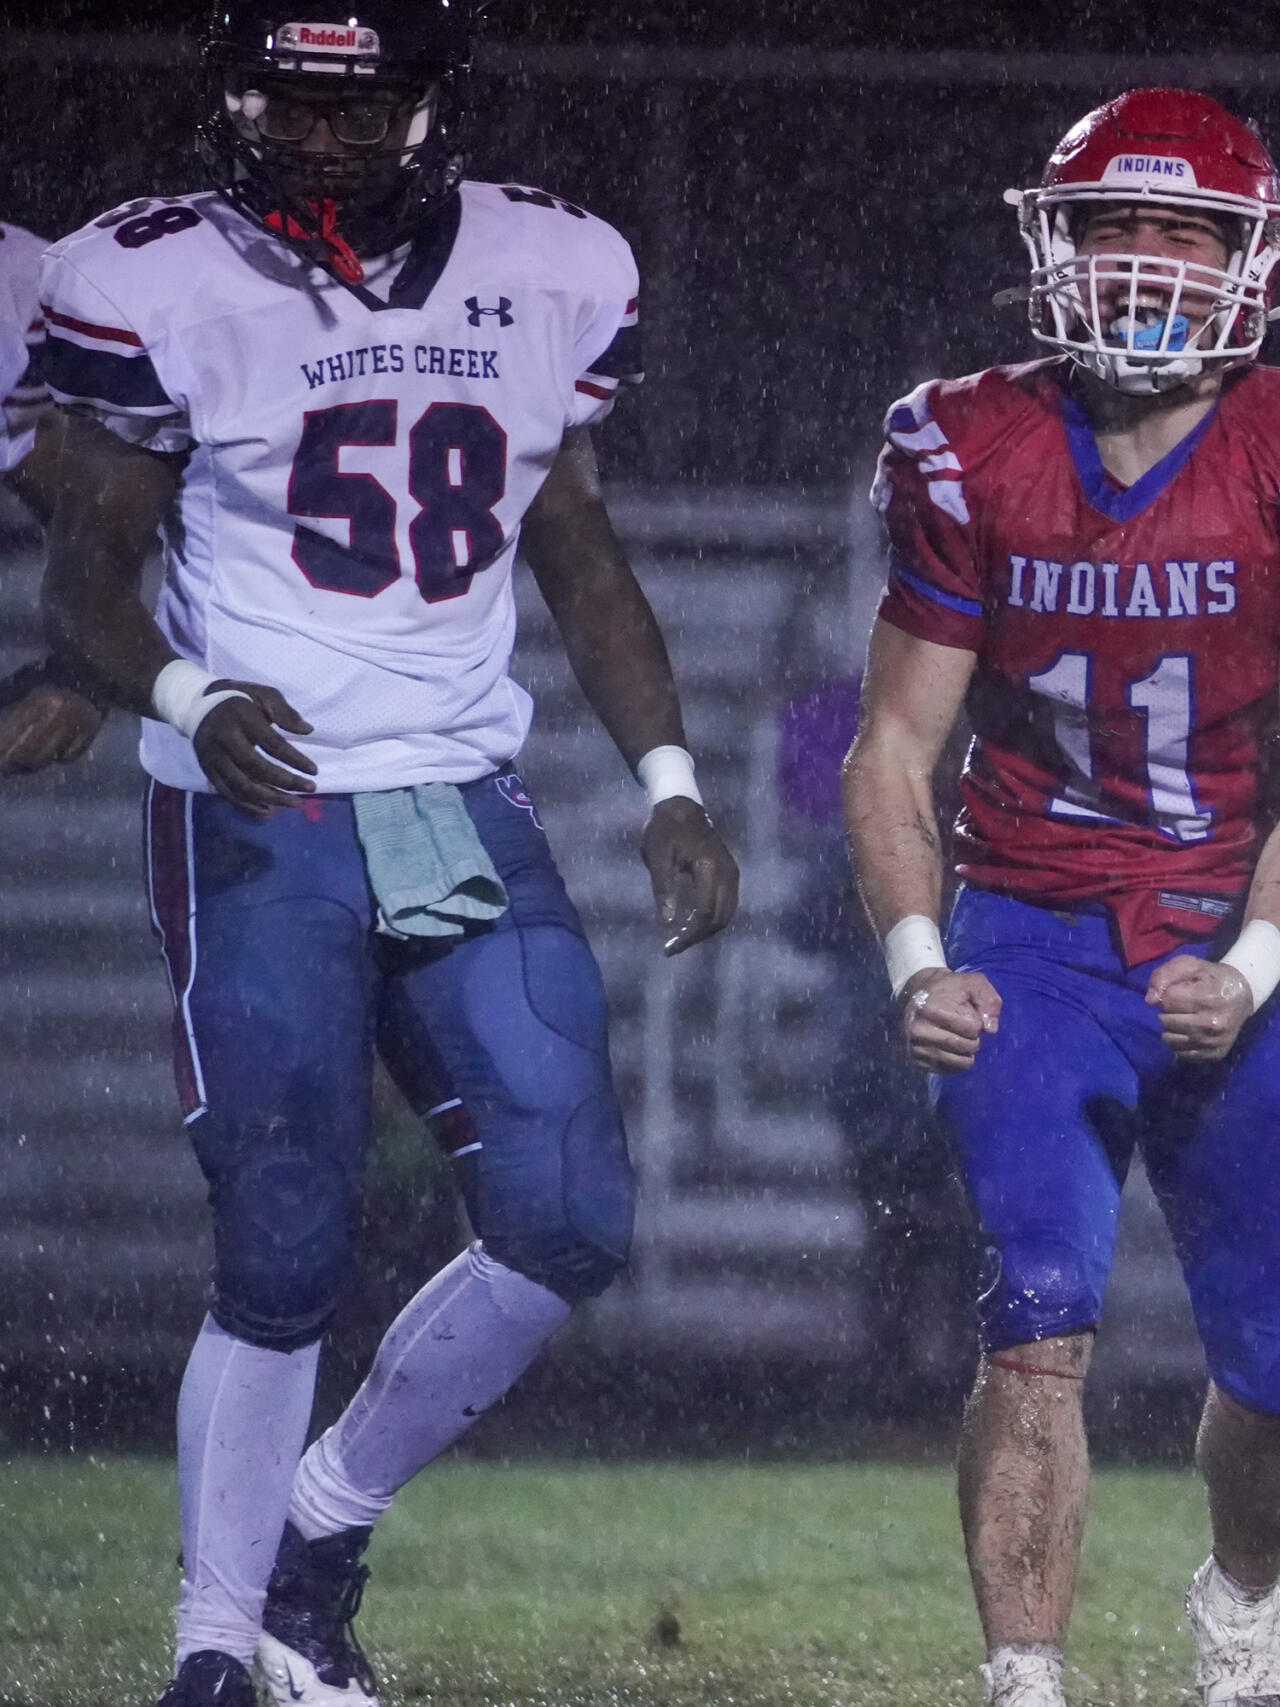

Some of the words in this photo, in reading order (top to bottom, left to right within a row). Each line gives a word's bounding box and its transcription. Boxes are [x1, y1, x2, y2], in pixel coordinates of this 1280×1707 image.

[299, 26, 357, 47] Riddell
[1117, 157, 1186, 178] INDIANS
[300, 344, 404, 390] WHITES
[414, 345, 500, 379] CREEK
[287, 399, 508, 604] 58
[1006, 554, 1239, 618] INDIANS
[1026, 649, 1215, 844] 11
